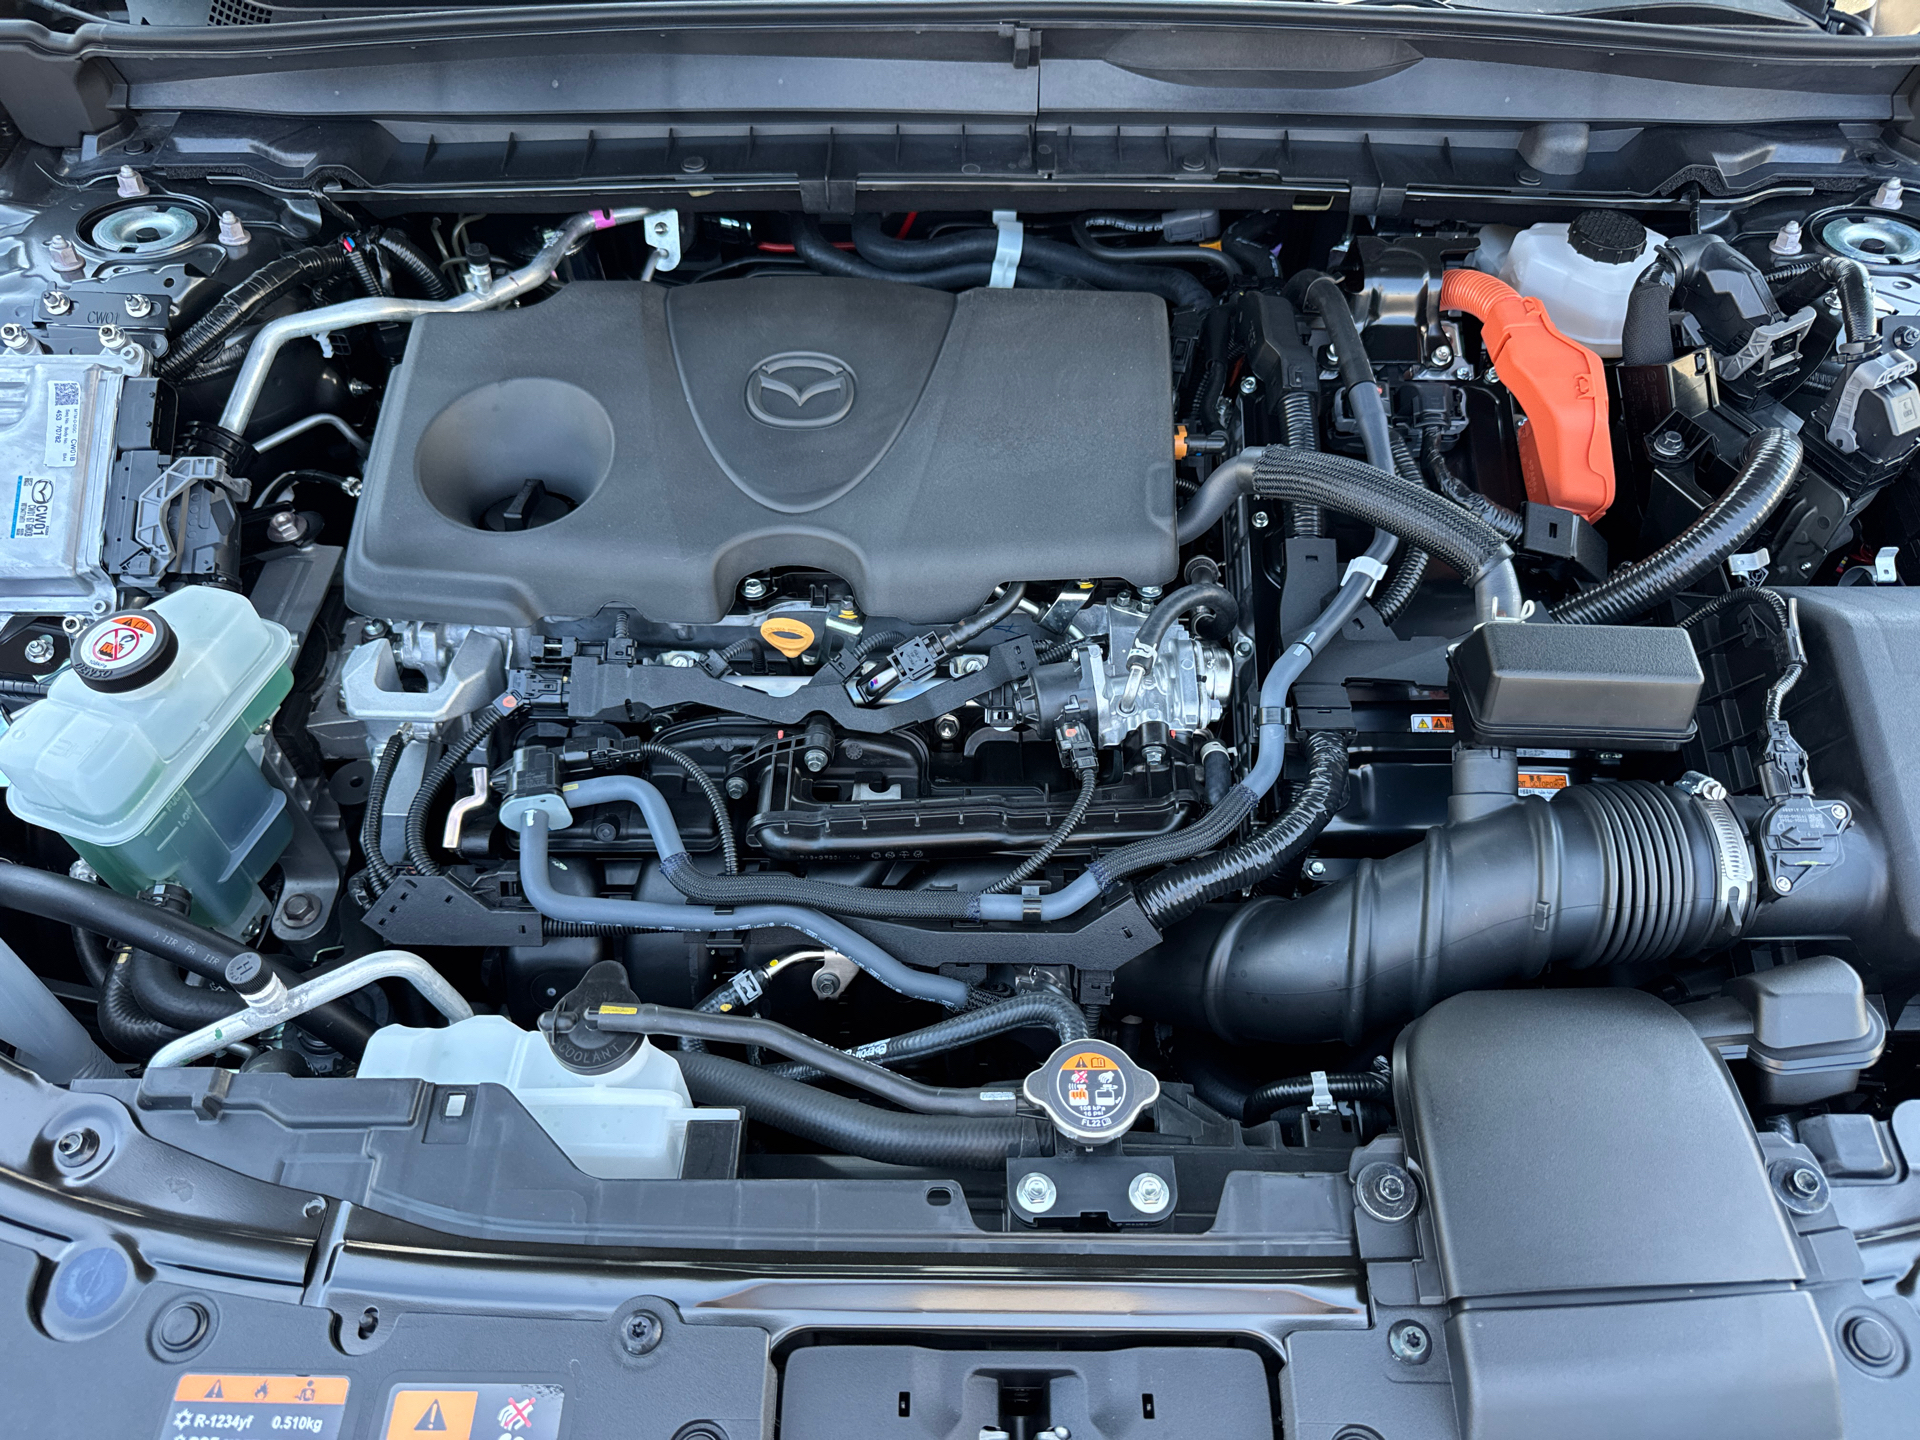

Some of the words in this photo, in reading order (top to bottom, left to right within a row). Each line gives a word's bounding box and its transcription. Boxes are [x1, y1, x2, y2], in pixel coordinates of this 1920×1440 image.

[87, 310, 119, 324] CW01
[33, 505, 48, 536] CW01
[75, 662, 113, 678] DENSO
[177, 804, 194, 828] LOW
[184, 944, 197, 956] PA
[558, 1042, 621, 1064] COOLANT
[1081, 1118, 1101, 1127] FL22
[193, 1413, 255, 1432] R-1234yf
[271, 1415, 323, 1434] 0.510kg
